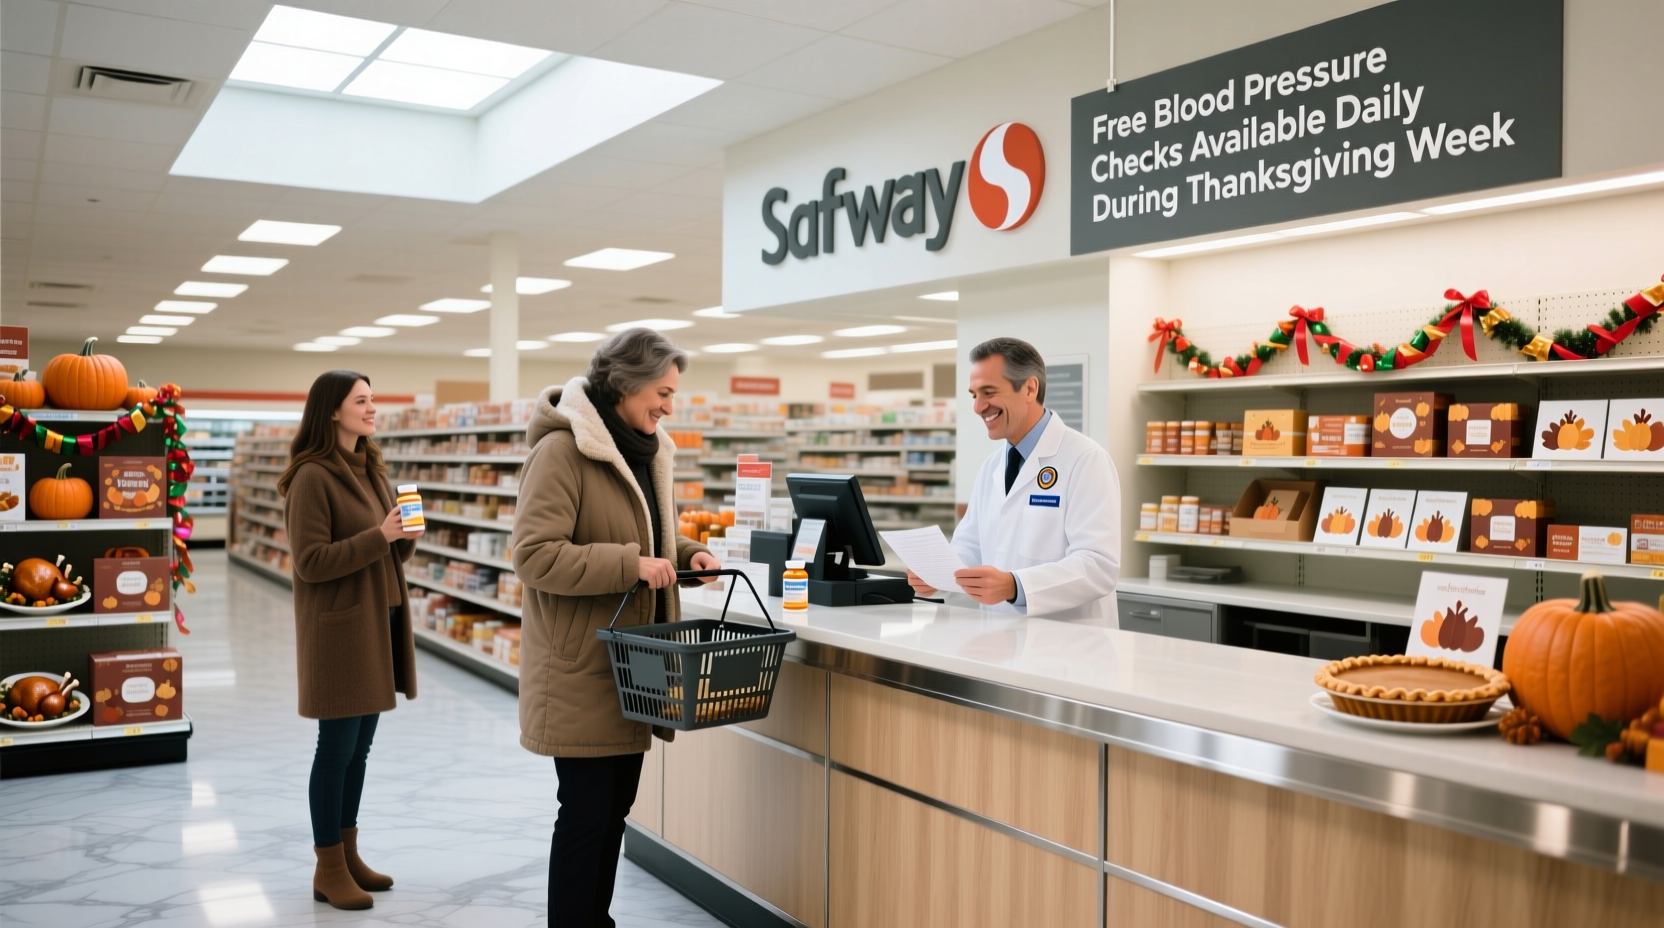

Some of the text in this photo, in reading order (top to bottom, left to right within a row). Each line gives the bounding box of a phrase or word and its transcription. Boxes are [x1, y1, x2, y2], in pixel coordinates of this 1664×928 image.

[1090, 82, 1424, 183] Checks Available Daily
[1092, 47, 1387, 145] Free Blood Pressure
[761, 160, 966, 266] Safway
[1092, 112, 1516, 223] During Thanksgiving Week
